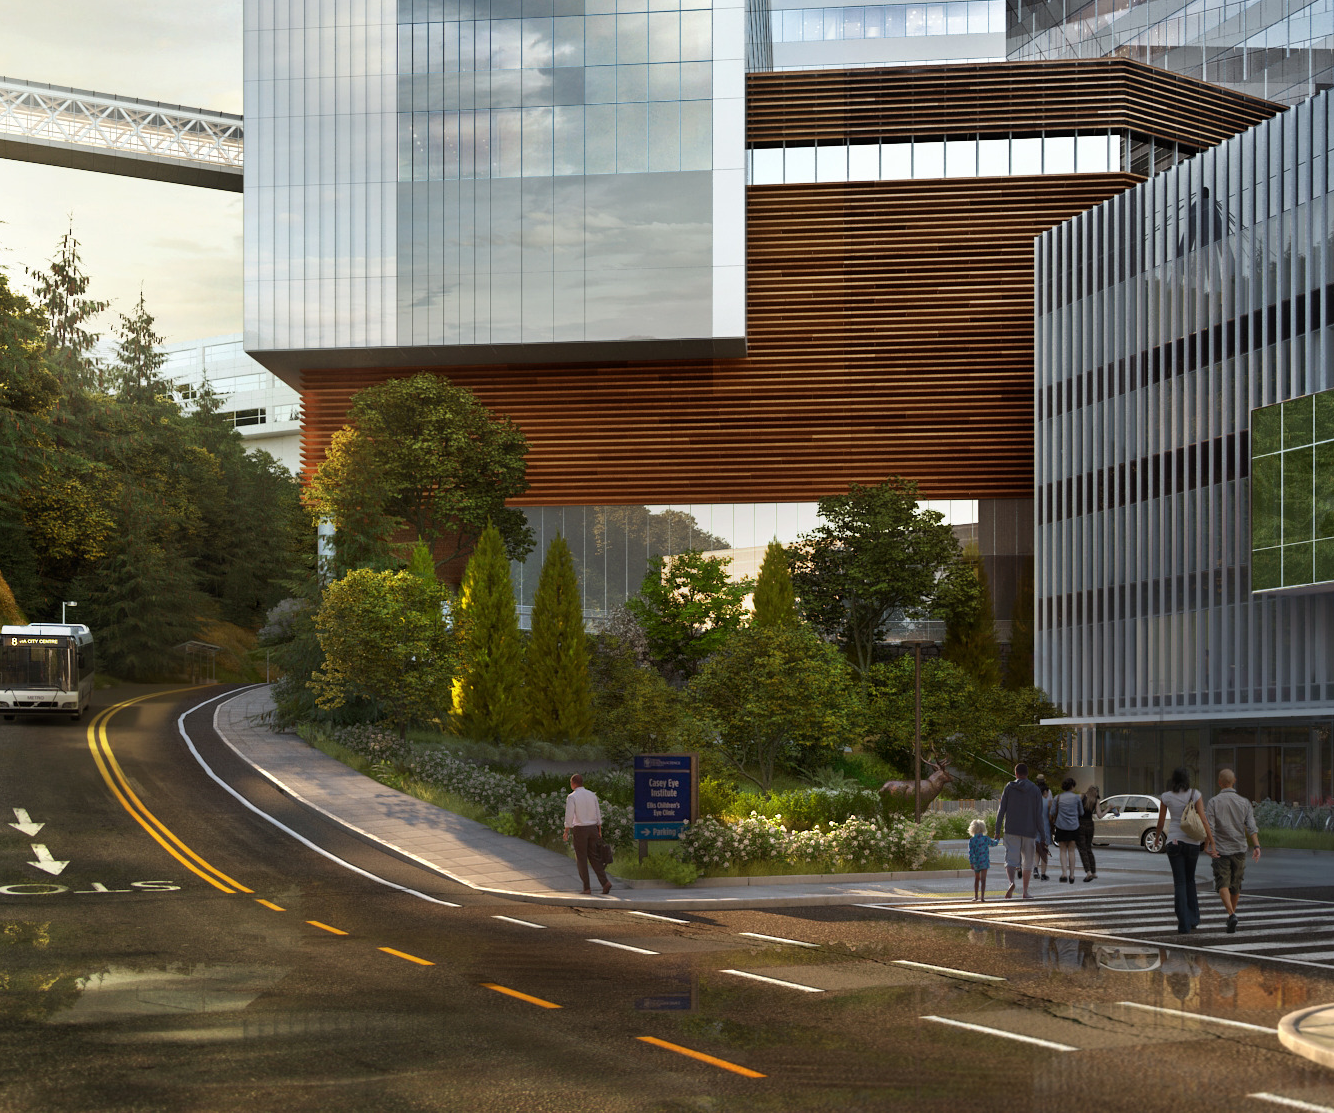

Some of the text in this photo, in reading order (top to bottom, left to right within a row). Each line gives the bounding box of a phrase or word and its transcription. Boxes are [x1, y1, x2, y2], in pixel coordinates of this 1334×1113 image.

[649, 778, 679, 788] Casey Eye
[651, 788, 677, 797] Institute
[653, 809, 662, 817] Eye
[652, 828, 676, 837] Parking
